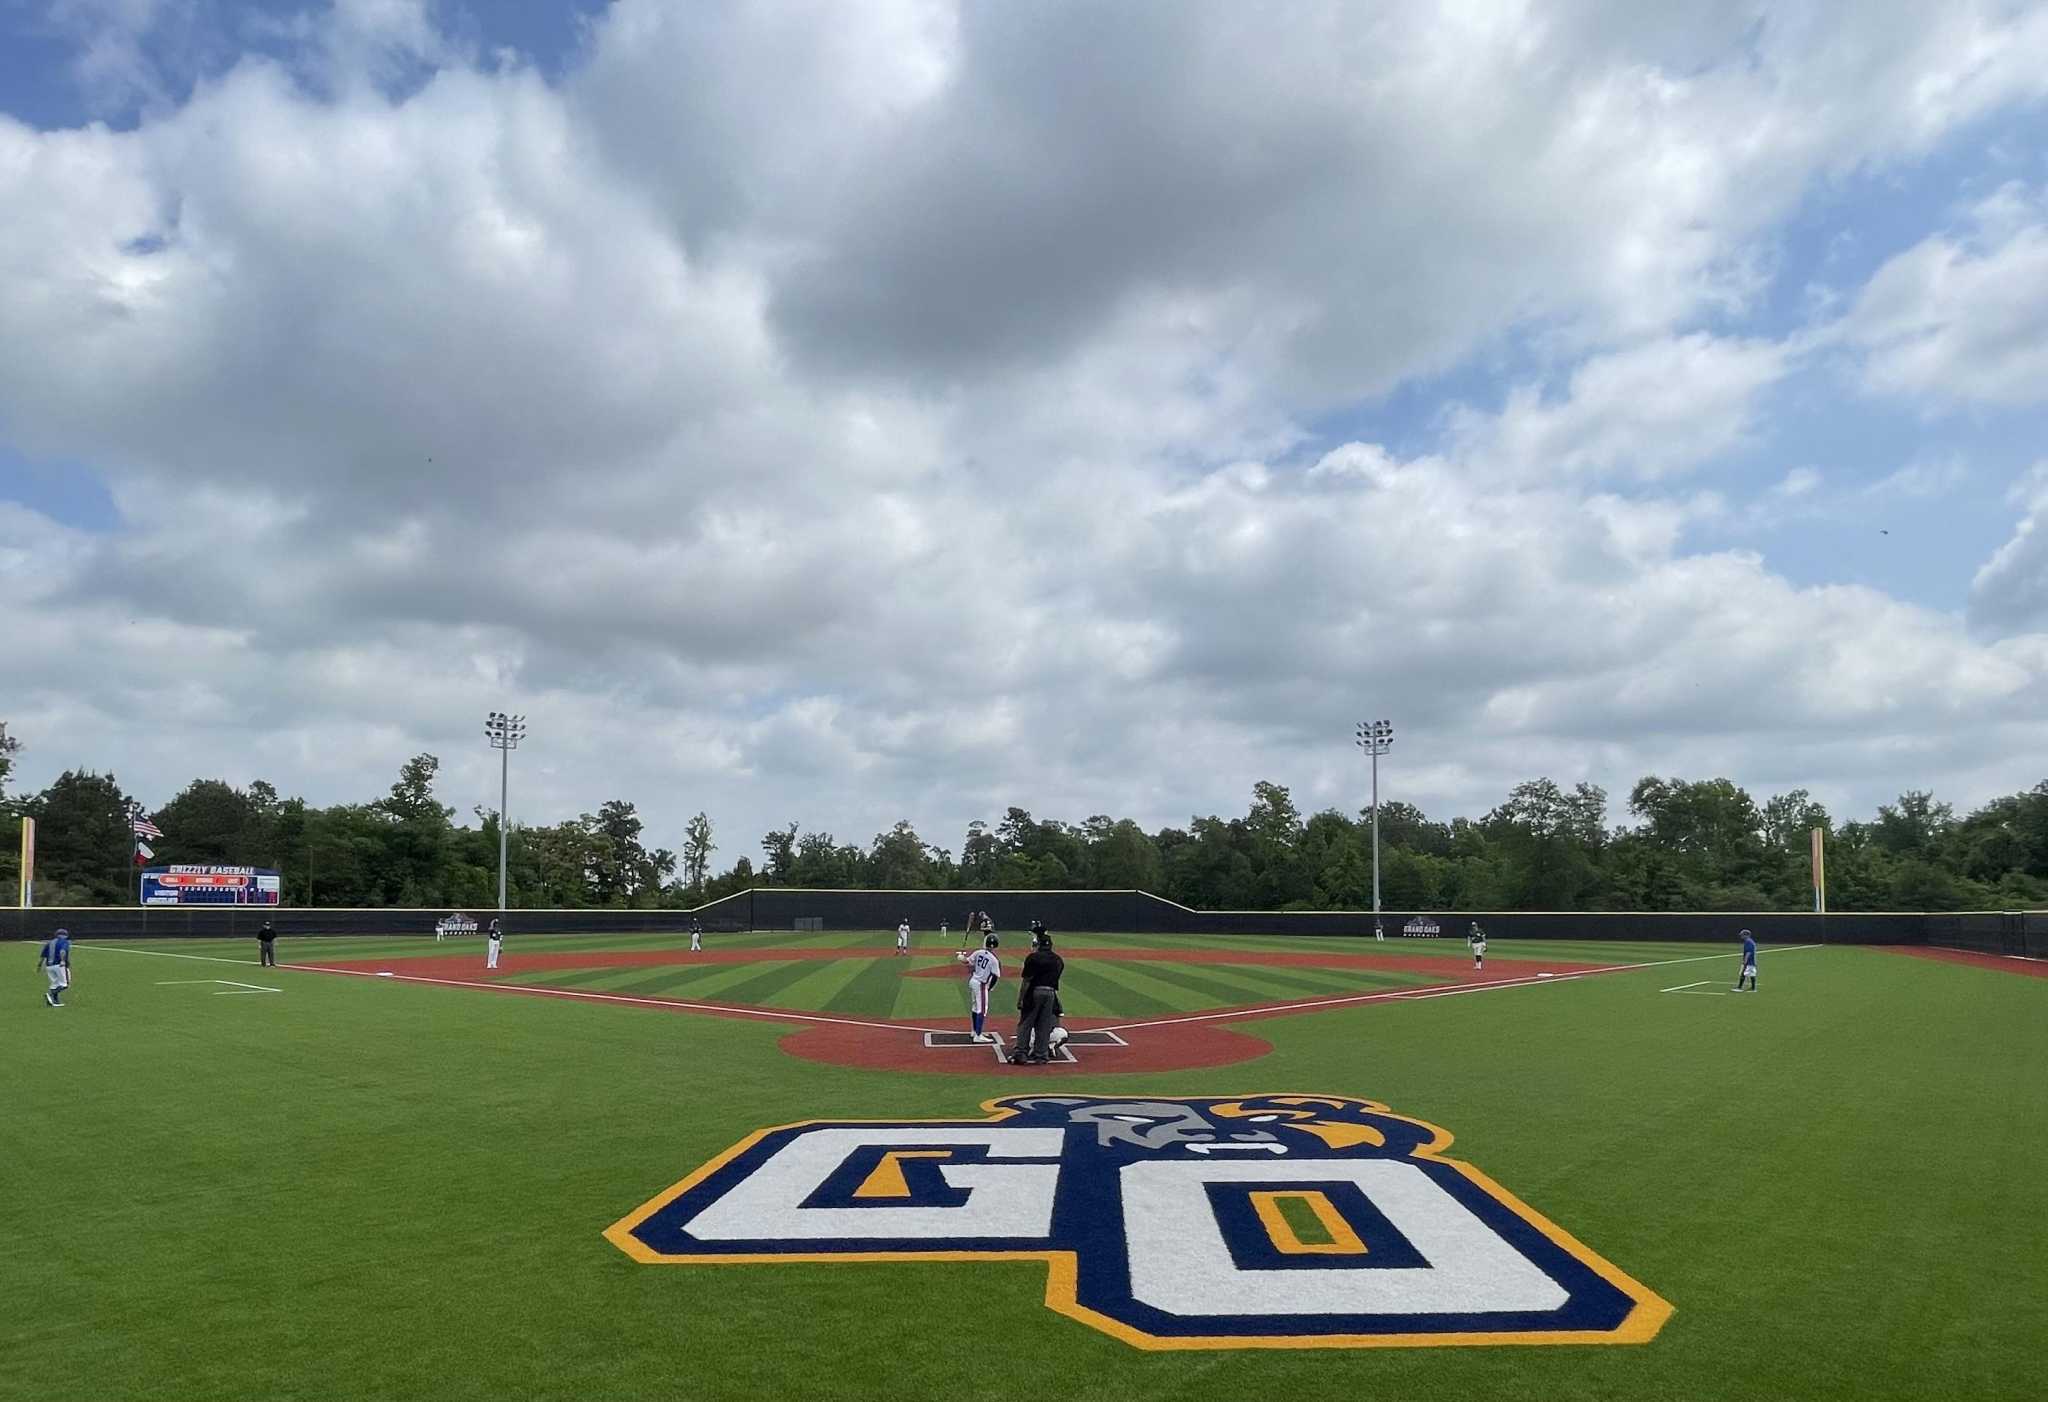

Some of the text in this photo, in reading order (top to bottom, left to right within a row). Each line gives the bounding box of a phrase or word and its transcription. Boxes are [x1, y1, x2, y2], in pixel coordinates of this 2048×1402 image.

[169, 865, 255, 874] GRIZZLY BASEBALL
[1403, 925, 1440, 933] GRAND OAKS
[977, 955, 989, 970] 20
[676, 1125, 1577, 1318] GO
